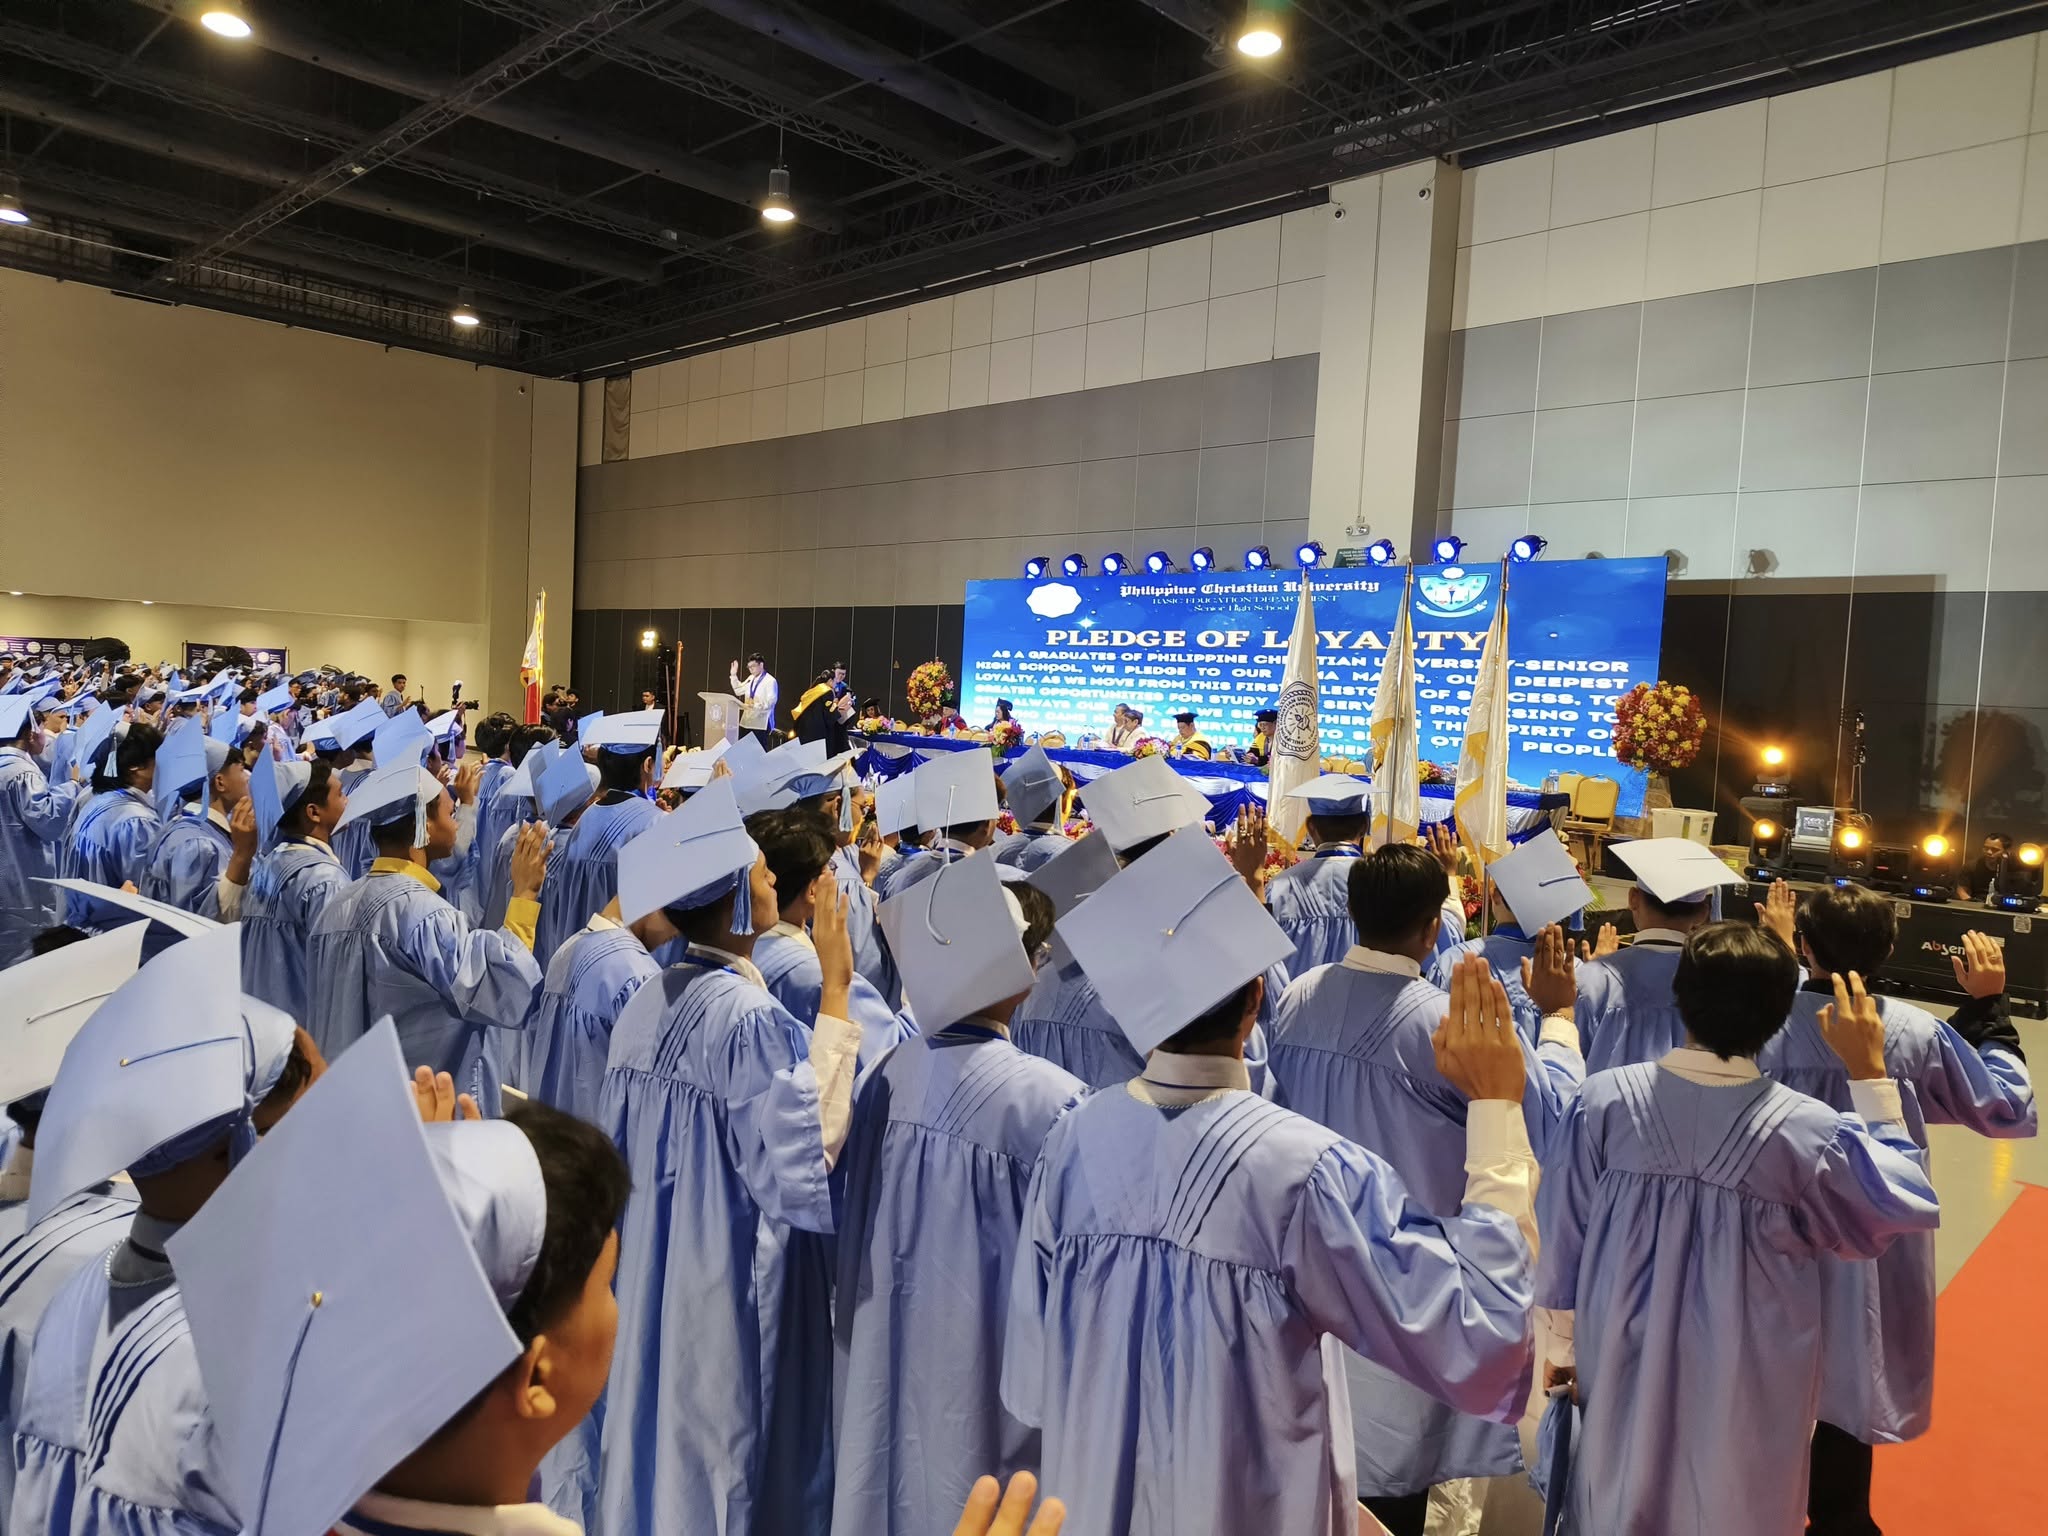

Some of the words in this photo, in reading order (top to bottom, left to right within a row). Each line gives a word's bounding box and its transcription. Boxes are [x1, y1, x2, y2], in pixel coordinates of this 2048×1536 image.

[1120, 583, 1196, 597] Philippine
[1200, 581, 1278, 595] Christian
[1045, 630, 1186, 647] PLEDGE
[1195, 630, 1250, 648] OF
[992, 650, 1011, 658] AS
[1014, 650, 1025, 658] A
[1028, 651, 1116, 661] GRADUATES
[1121, 653, 1142, 662] OF
[1147, 653, 1248, 664] PHILIPPINE
[975, 661, 1011, 670] HIGH
[1091, 664, 1115, 674] WE
[1124, 666, 1187, 676] PLEDGE
[1196, 667, 1221, 677] TO
[1231, 668, 1272, 678] OUR
[1446, 674, 1478, 685] OU
[1514, 675, 1629, 689] DEEPEST
[1041, 675, 1061, 684] AS
[1063, 676, 1087, 685] WE
[1090, 677, 1135, 688] MOVE
[1138, 679, 1185, 690] FROM
[1189, 680, 1231, 691] THIS
[1236, 682, 1281, 692] FIRS
[1419, 689, 1451, 700] OF
[1168, 692, 1204, 704] FOR
[1209, 694, 1269, 706] STUDY
[1196, 707, 1224, 718] WE
[1508, 724, 1576, 738] PIRIT
[1921, 940, 1965, 956] Absen
